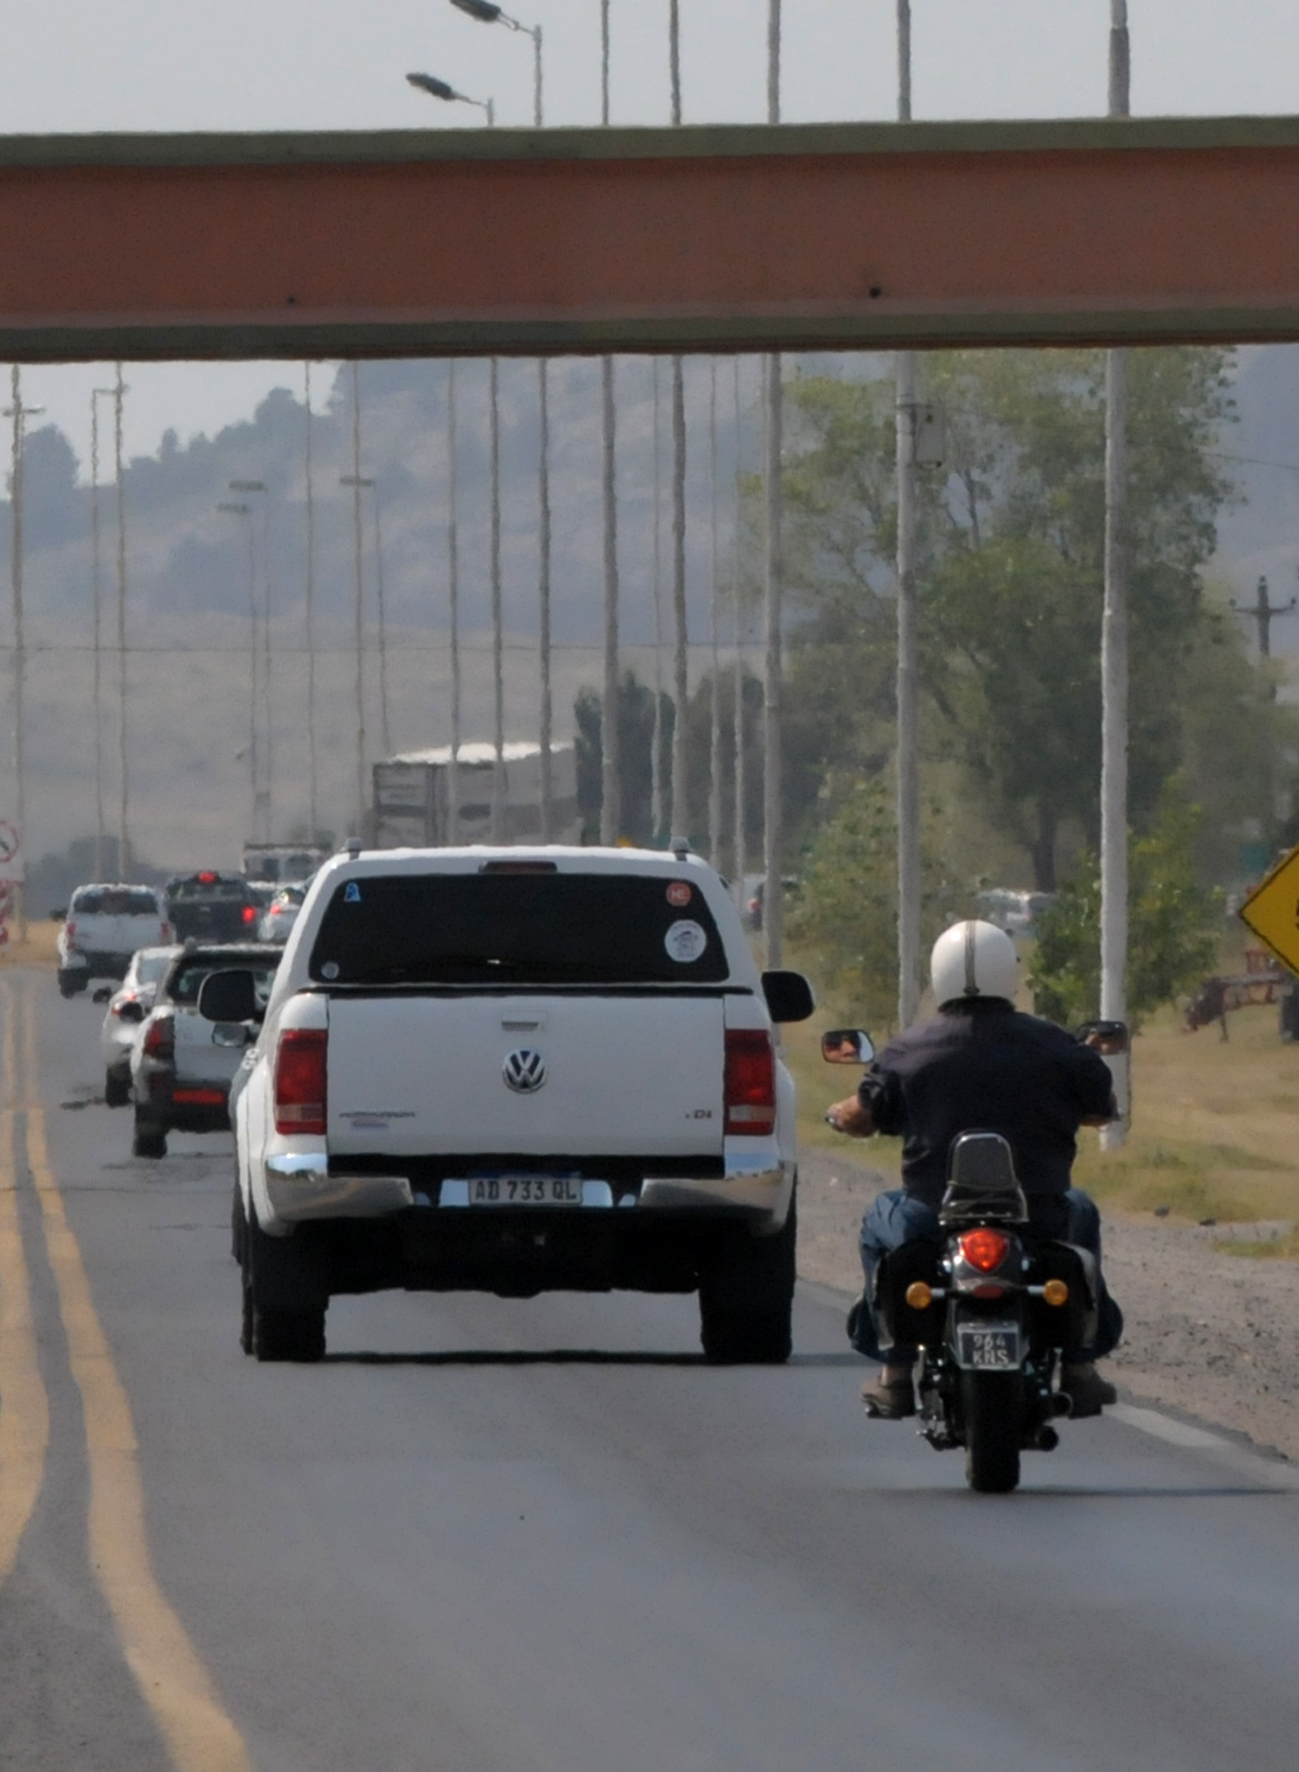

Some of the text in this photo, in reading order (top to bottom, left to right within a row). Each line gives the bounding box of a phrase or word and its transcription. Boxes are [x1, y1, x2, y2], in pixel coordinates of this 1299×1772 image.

[475, 1180, 577, 1201] AD 733 QL
